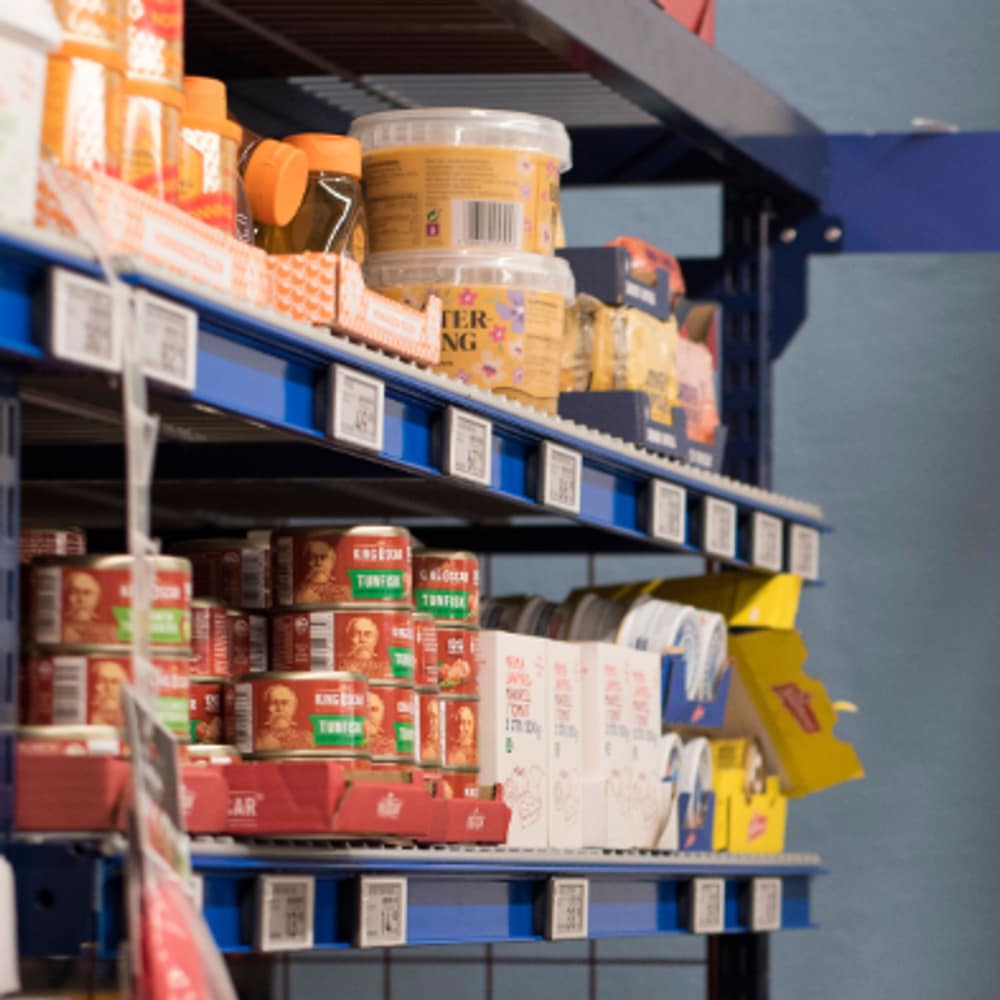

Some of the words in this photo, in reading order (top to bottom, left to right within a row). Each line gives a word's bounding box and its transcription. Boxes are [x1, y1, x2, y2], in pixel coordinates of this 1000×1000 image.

[353, 548, 378, 561] KING
[356, 574, 401, 588] TUNFISK
[315, 693, 340, 706] KING
